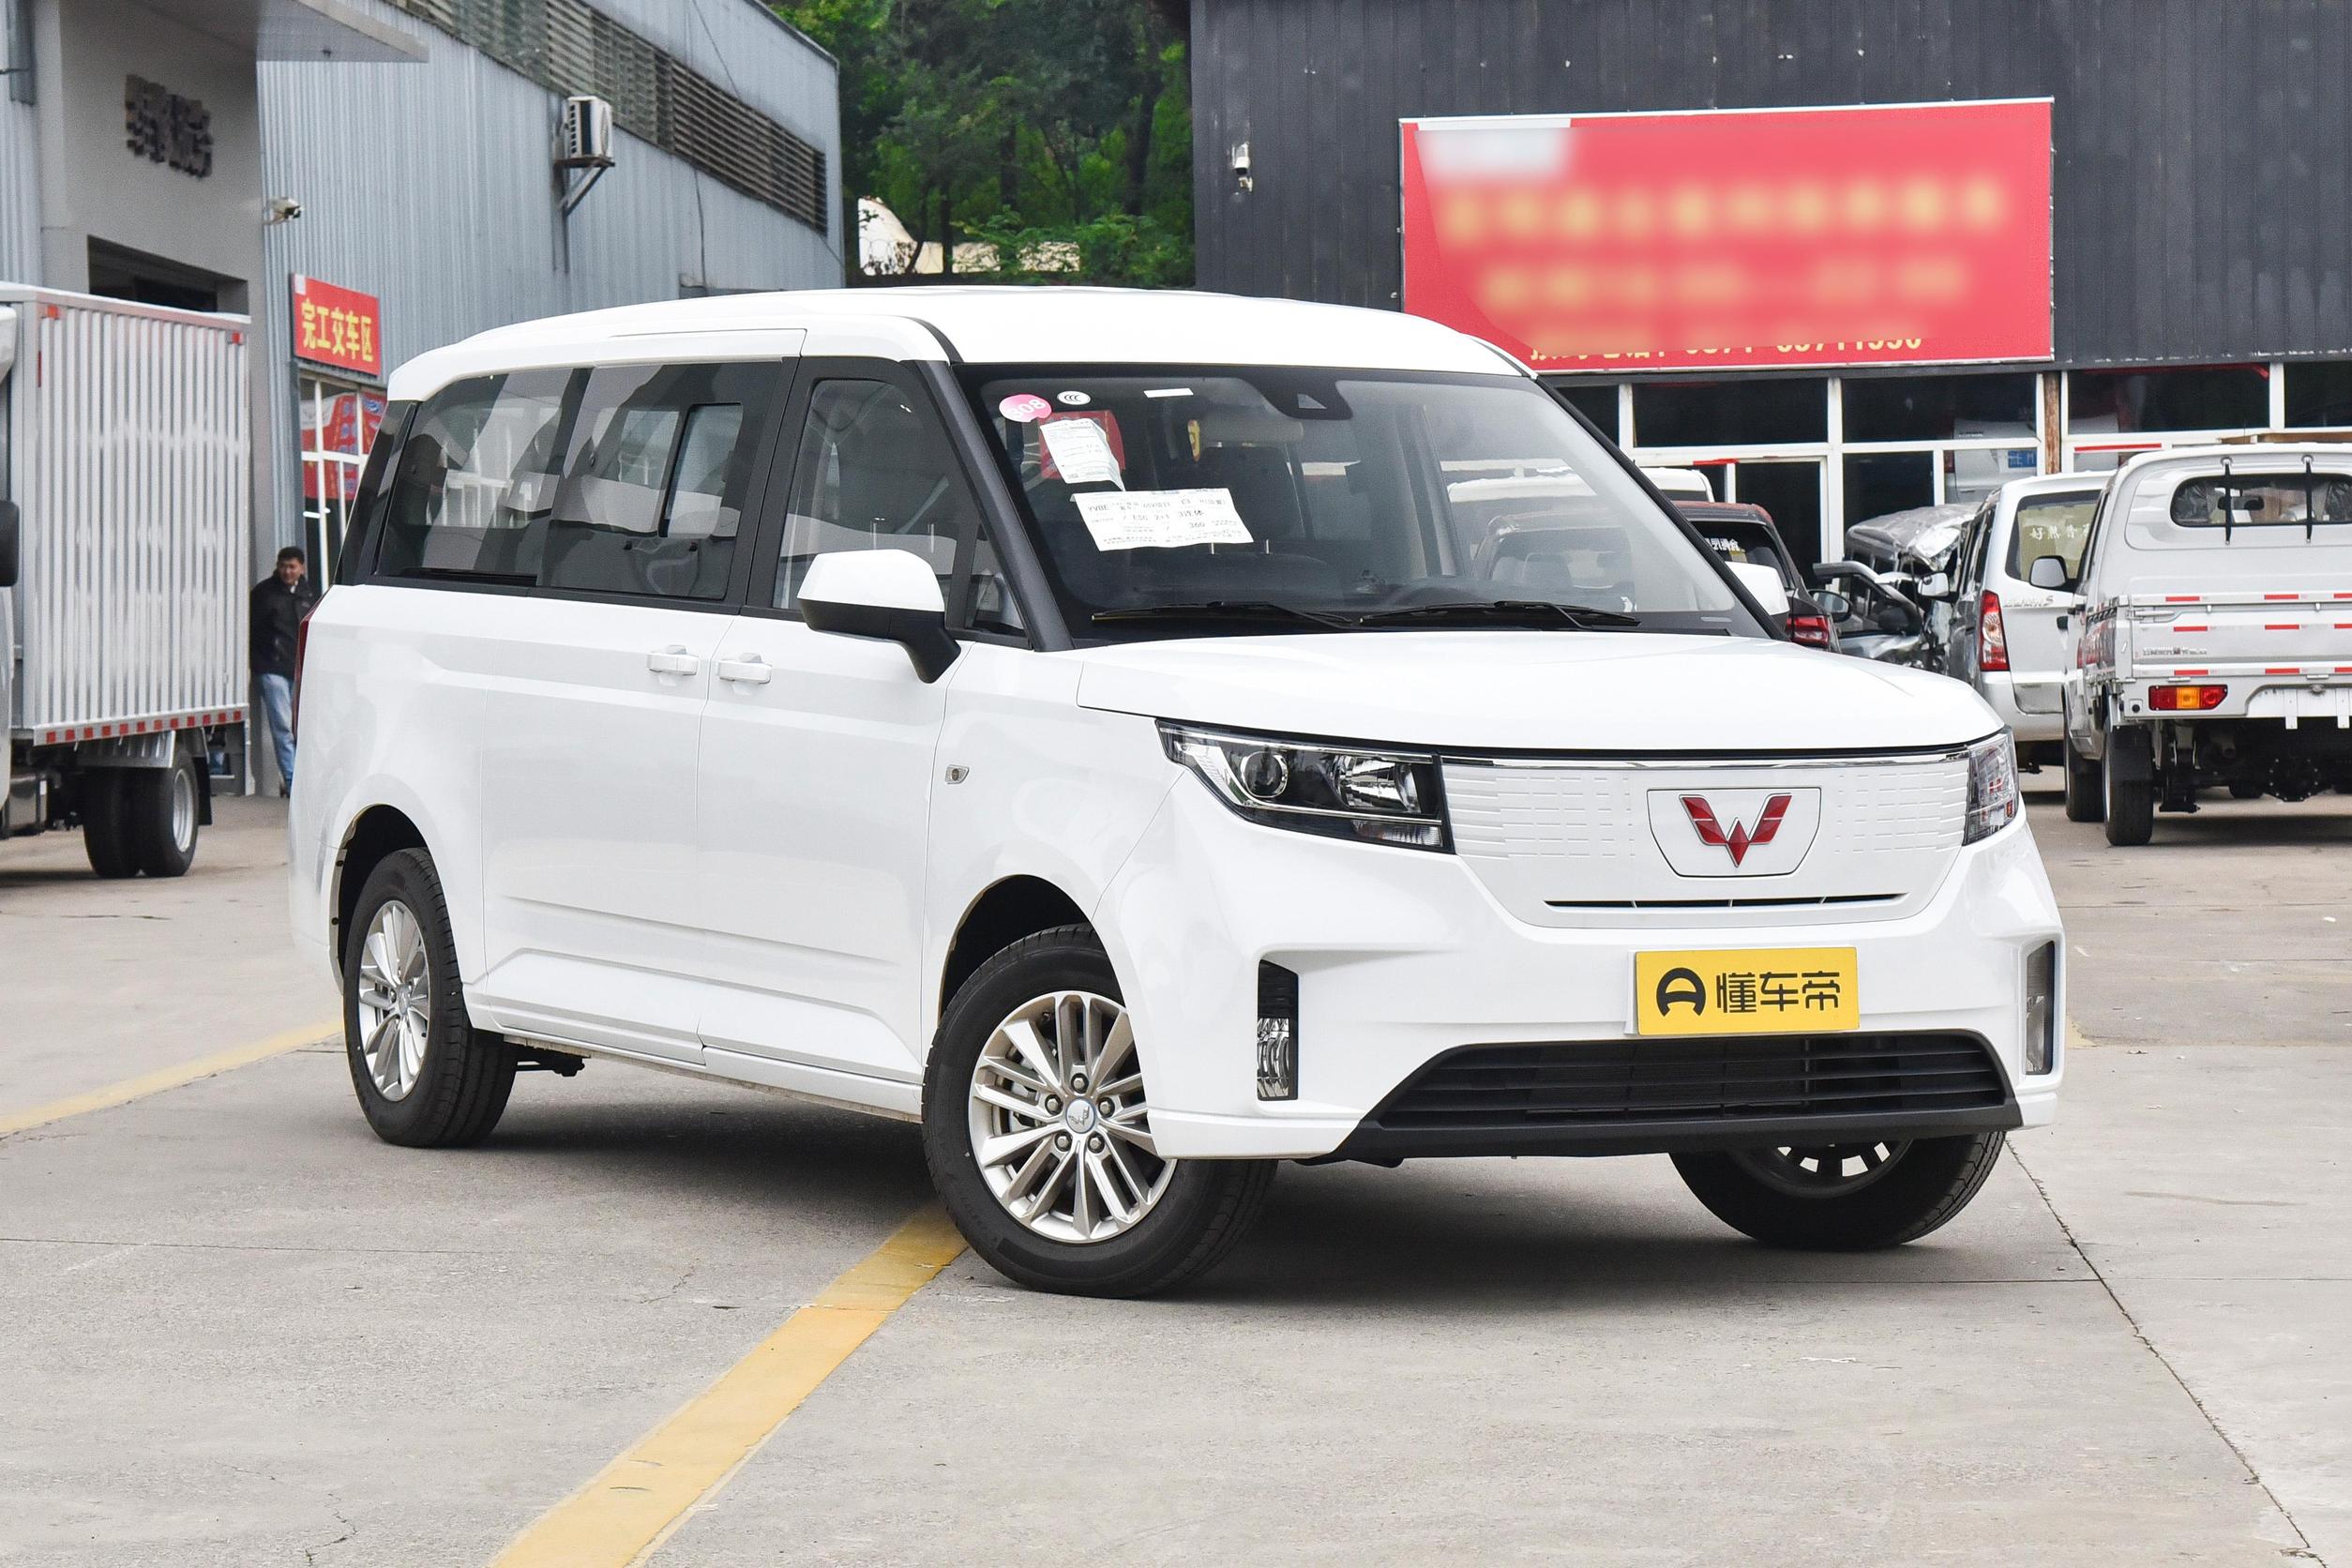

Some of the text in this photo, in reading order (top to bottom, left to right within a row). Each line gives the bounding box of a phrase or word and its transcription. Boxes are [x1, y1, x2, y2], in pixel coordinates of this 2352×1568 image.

[302, 297, 373, 362] 完工交车区
[1715, 970, 1841, 1014] 懂车帝
